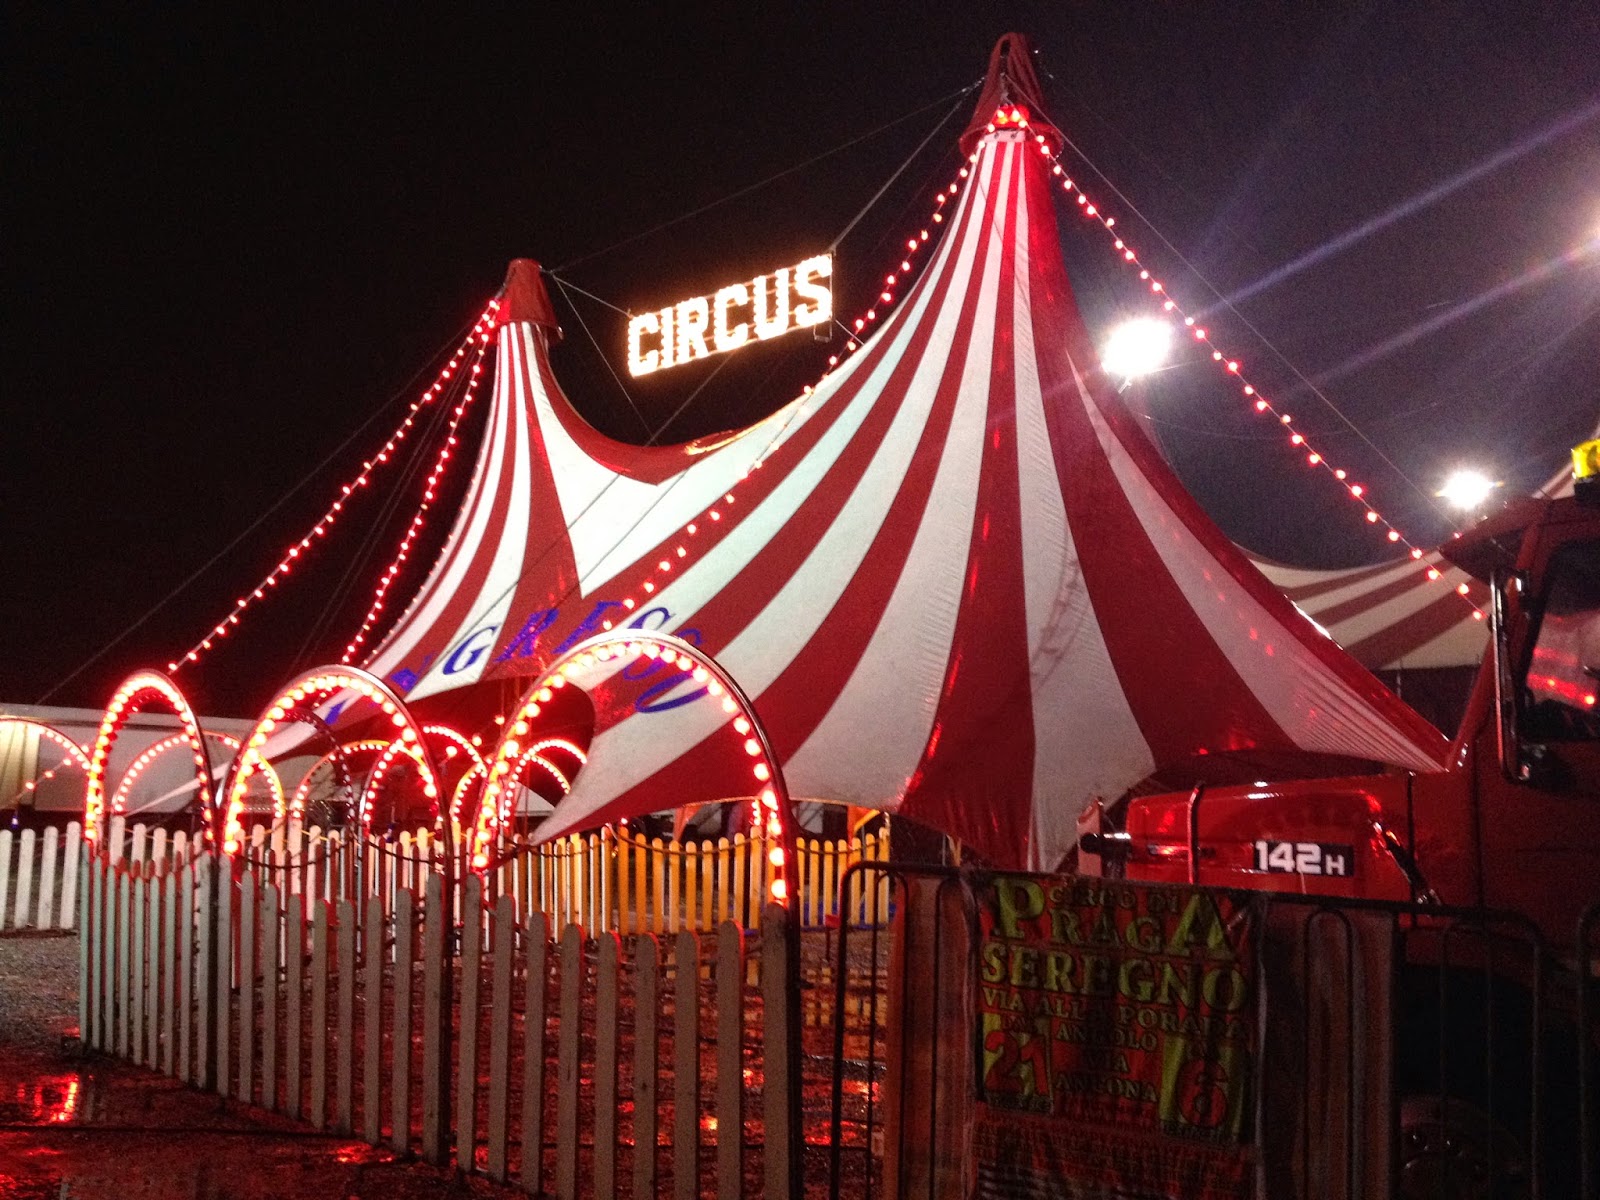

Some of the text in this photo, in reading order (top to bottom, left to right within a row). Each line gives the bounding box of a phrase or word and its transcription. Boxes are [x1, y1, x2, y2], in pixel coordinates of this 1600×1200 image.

[628, 254, 833, 378] CIRCUS
[993, 877, 1236, 961] PRAGA
[1048, 886, 1136, 910] CRCO
[981, 941, 1248, 1012] SEREGNO
[983, 987, 1026, 1012] VIA
[984, 1029, 1051, 1097] 21
